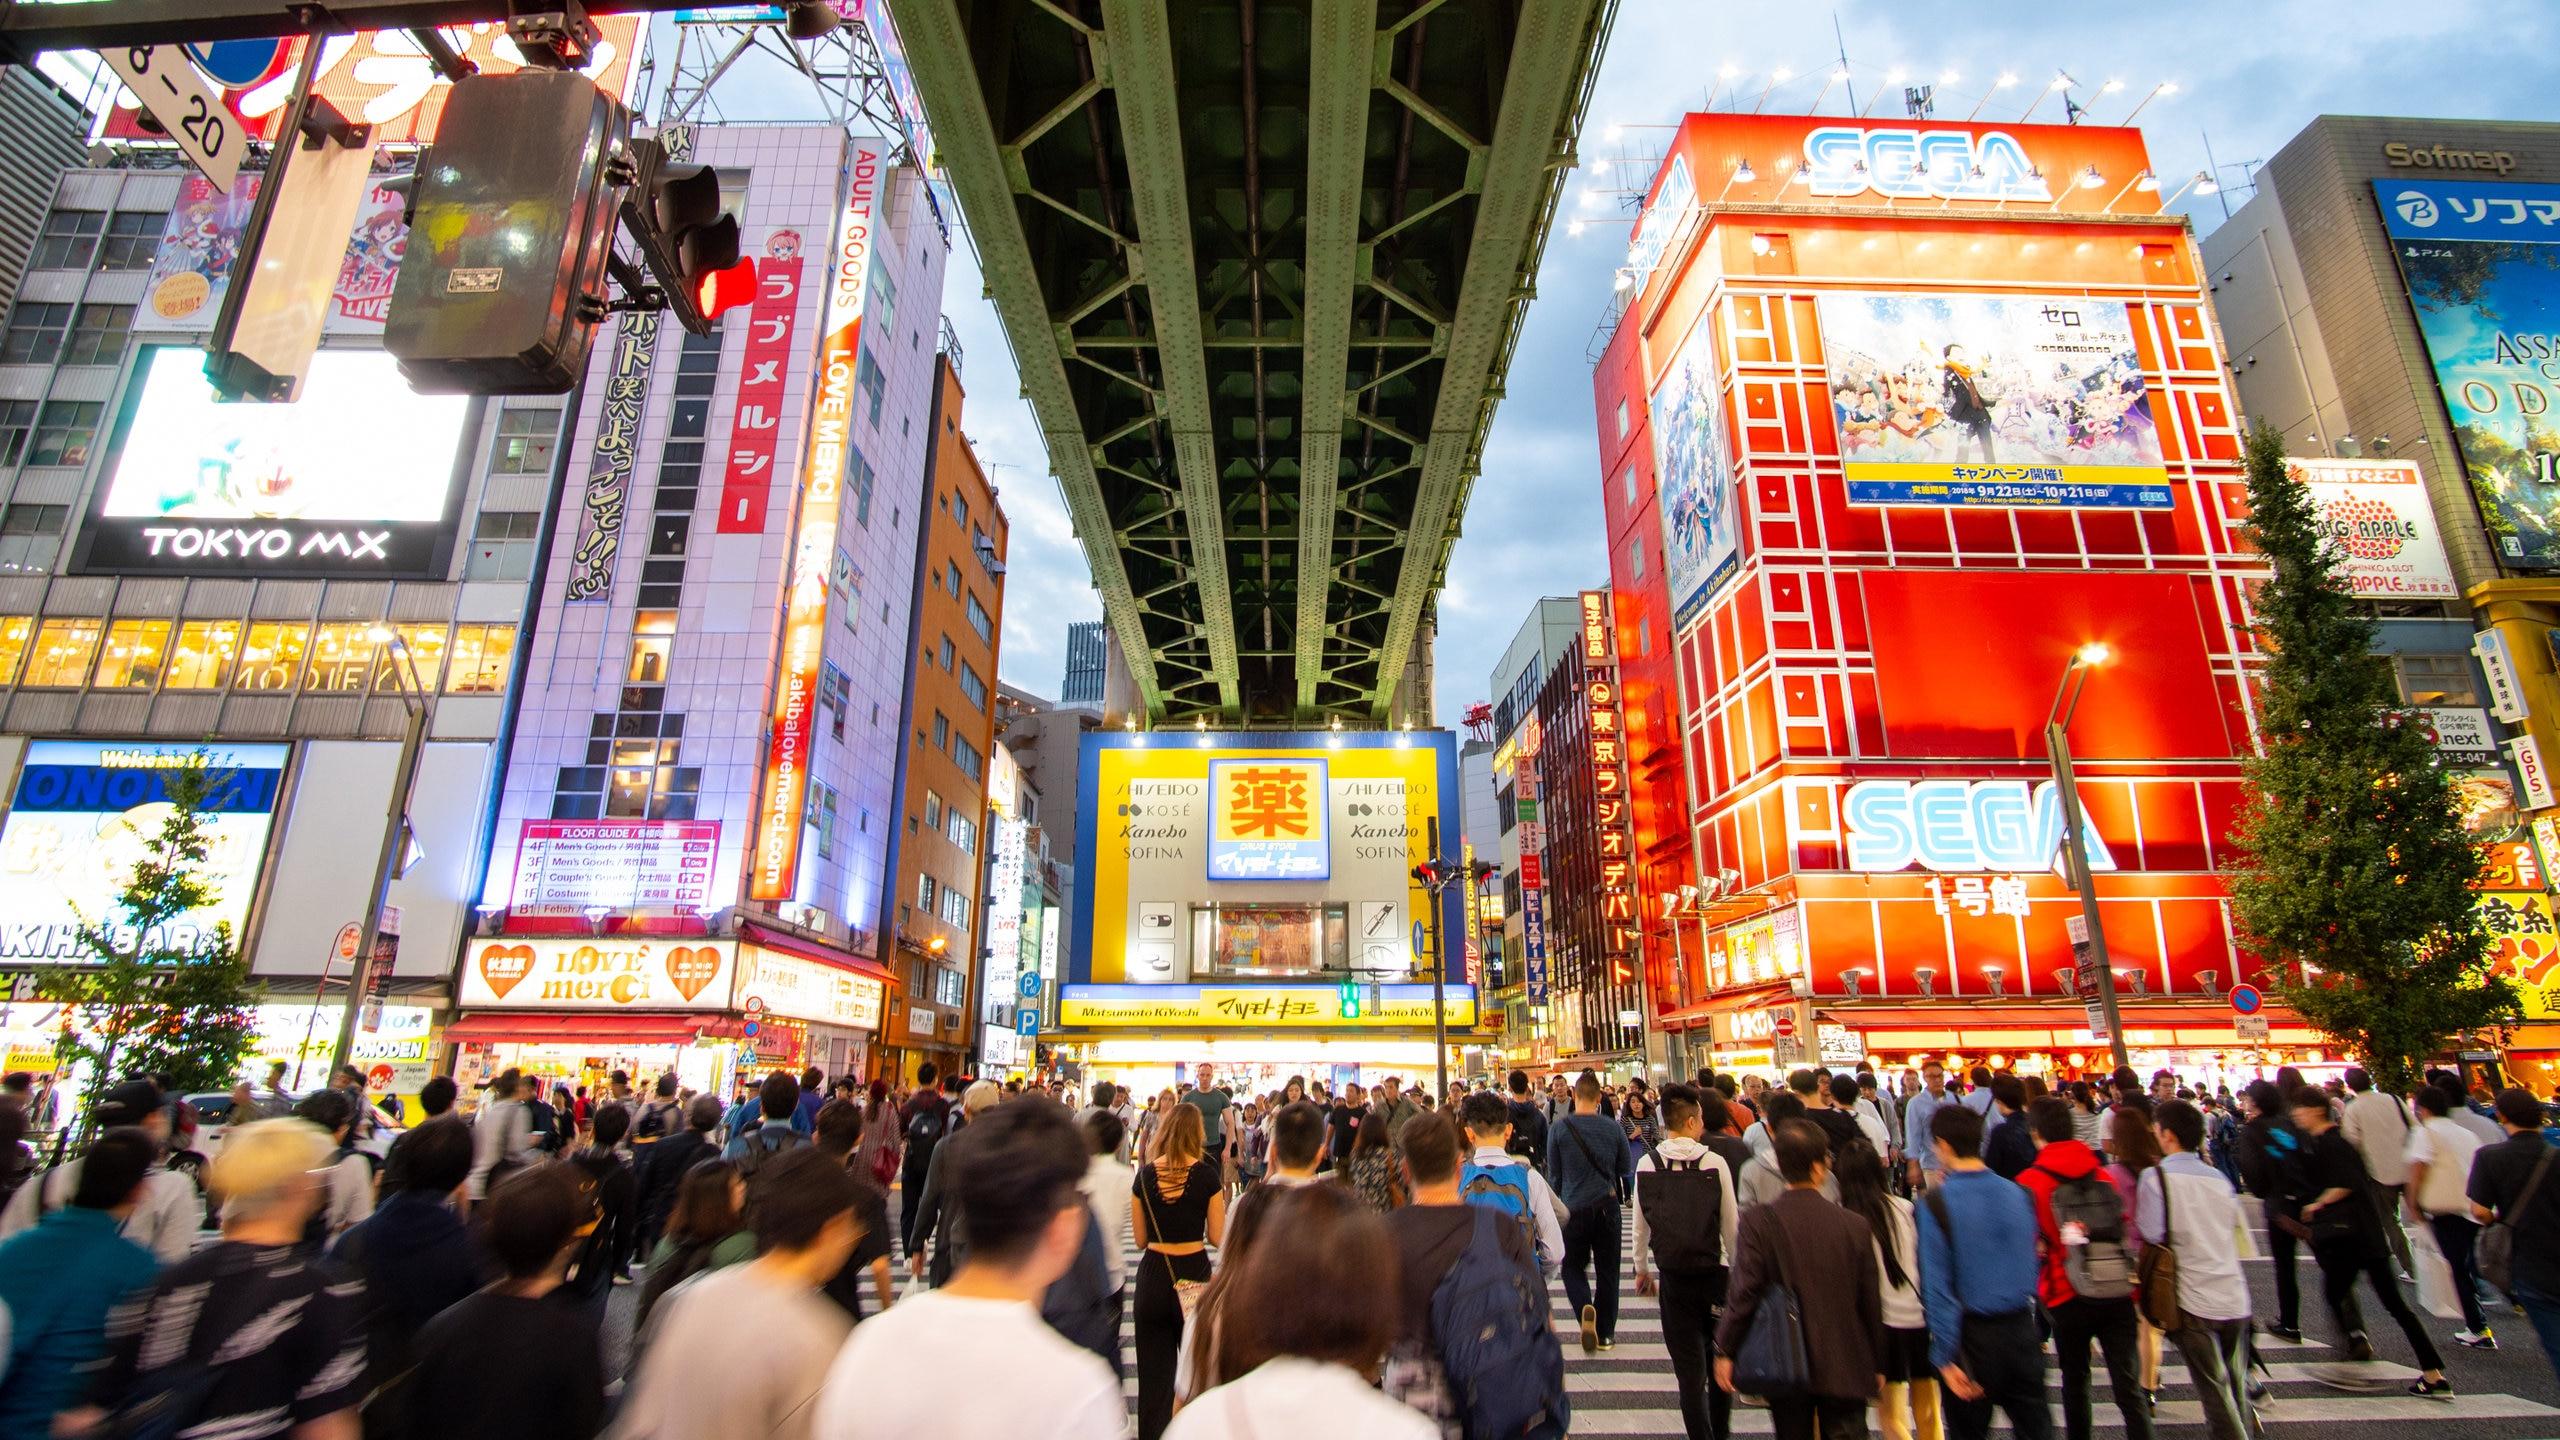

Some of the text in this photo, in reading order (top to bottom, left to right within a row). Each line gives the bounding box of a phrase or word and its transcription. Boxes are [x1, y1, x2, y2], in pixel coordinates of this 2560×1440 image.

[1803, 127, 2053, 203] SEGA
[2385, 143, 2518, 177] Sofmap
[837, 148, 877, 308] ADULT GOODS
[2421, 249, 2453, 258] PS4
[2496, 331, 2560, 365] ASS
[732, 274, 794, 522] ラブメルシー
[2464, 381, 2560, 415] OD
[810, 349, 852, 502] LOVE MERCI
[1953, 467, 2063, 481] キャンペーン開催!
[2357, 520, 2418, 540] APPLE
[143, 528, 391, 560] TOKYO MX
[2391, 564, 2415, 573] SLOT
[764, 625, 813, 886] www.akibalovemerci.com
[2520, 750, 2543, 793] GPS
[1117, 783, 1199, 797] SHISEIDO
[1338, 782, 1428, 797] SHISEIDO
[1146, 803, 1191, 817] KOSÉ
[1231, 768, 1309, 838] 薬
[1377, 803, 1421, 817] KOSÉ
[561, 828, 595, 838] FLOOR
[597, 828, 629, 839] GUIDE
[1119, 824, 1188, 839] Kanebo
[1351, 823, 1419, 839] Kanebo
[1842, 779, 2117, 872] SEGA
[530, 841, 545, 851] 4F
[554, 842, 582, 851] Men's
[584, 842, 617, 851] Goods
[625, 842, 660, 851] 男性用品
[1123, 847, 1183, 860] SOFINA
[1356, 847, 1417, 860] SOFINA
[1591, 711, 1632, 985] 東京ラジオデパート
[527, 856, 543, 866] 3F
[552, 857, 579, 866] Men's
[582, 857, 615, 866] Goods
[623, 858, 658, 867] 男性用品
[524, 871, 540, 882] 2F
[549, 872, 592, 883] Couple's
[523, 889, 537, 899] 1F
[546, 889, 592, 899] Costume
[1924, 875, 2032, 917] 1号館
[519, 904, 534, 914] B1
[543, 904, 575, 914] Fetish
[1467, 906, 1477, 940] SLOT
[1526, 890, 1544, 998] ホビーステーション
[1465, 941, 1482, 985] Aion
[1081, 1007, 1152, 1018] Matsumoto
[1217, 996, 1321, 1020] マツモトキヨシ
[280, 1012, 343, 1027] SON
[1022, 1011, 1036, 1034] P
[353, 1041, 424, 1059] ONODEN
